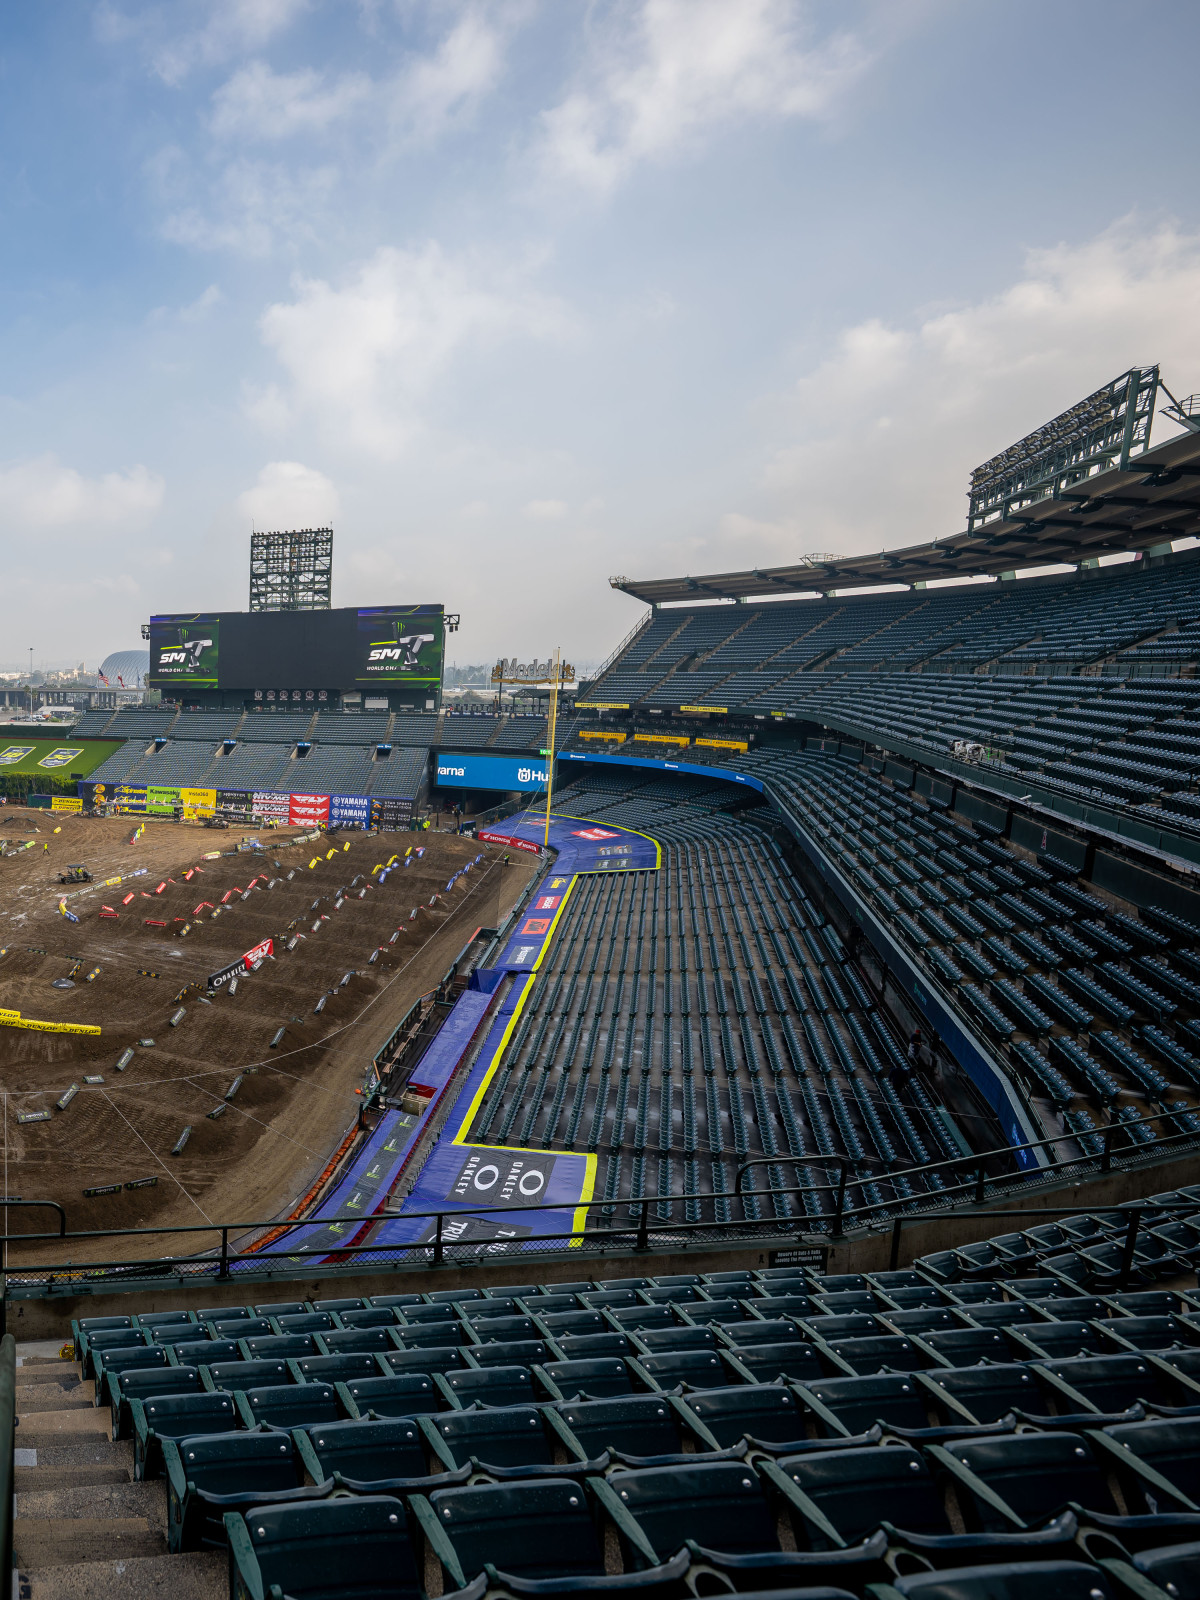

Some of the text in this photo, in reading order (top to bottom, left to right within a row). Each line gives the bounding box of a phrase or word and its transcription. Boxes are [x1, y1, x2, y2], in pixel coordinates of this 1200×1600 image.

[502, 658, 563, 677] Modelo
[340, 797, 368, 805] YAMAHA
[339, 808, 367, 817] YAMAHA
[490, 835, 511, 843] HONDA
[222, 964, 246, 981] OAKLEY
[26, 1023, 58, 1031] DUNLOP
[455, 1156, 481, 1196] OAKLEY
[500, 1161, 524, 1201] OAKLEY
